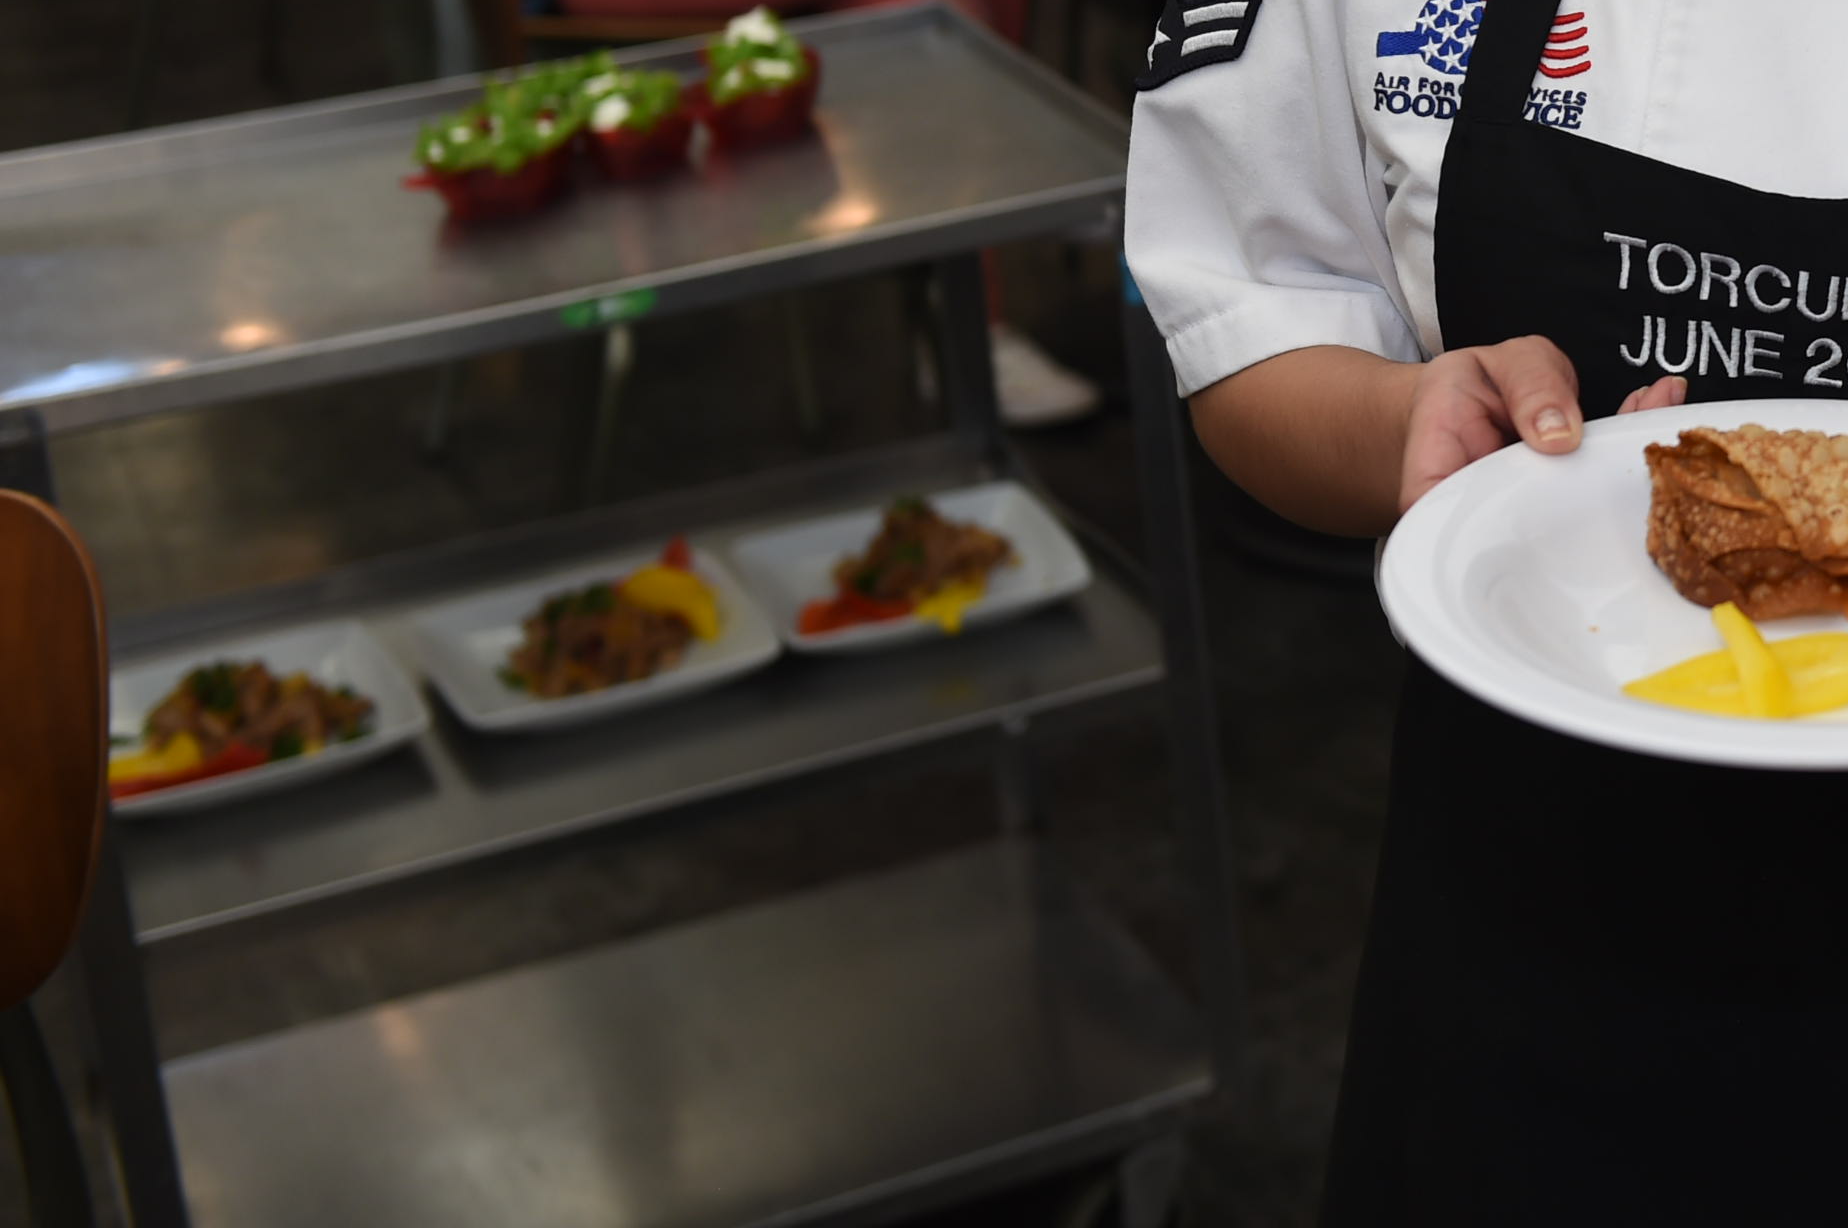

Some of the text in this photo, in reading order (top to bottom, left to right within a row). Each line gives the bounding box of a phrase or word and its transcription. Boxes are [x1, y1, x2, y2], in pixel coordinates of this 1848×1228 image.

[1373, 88, 1457, 119] FOOD
[1374, 71, 1410, 91] AIR
[1529, 86, 1587, 106] VICES
[1619, 315, 1784, 378] JUNE
